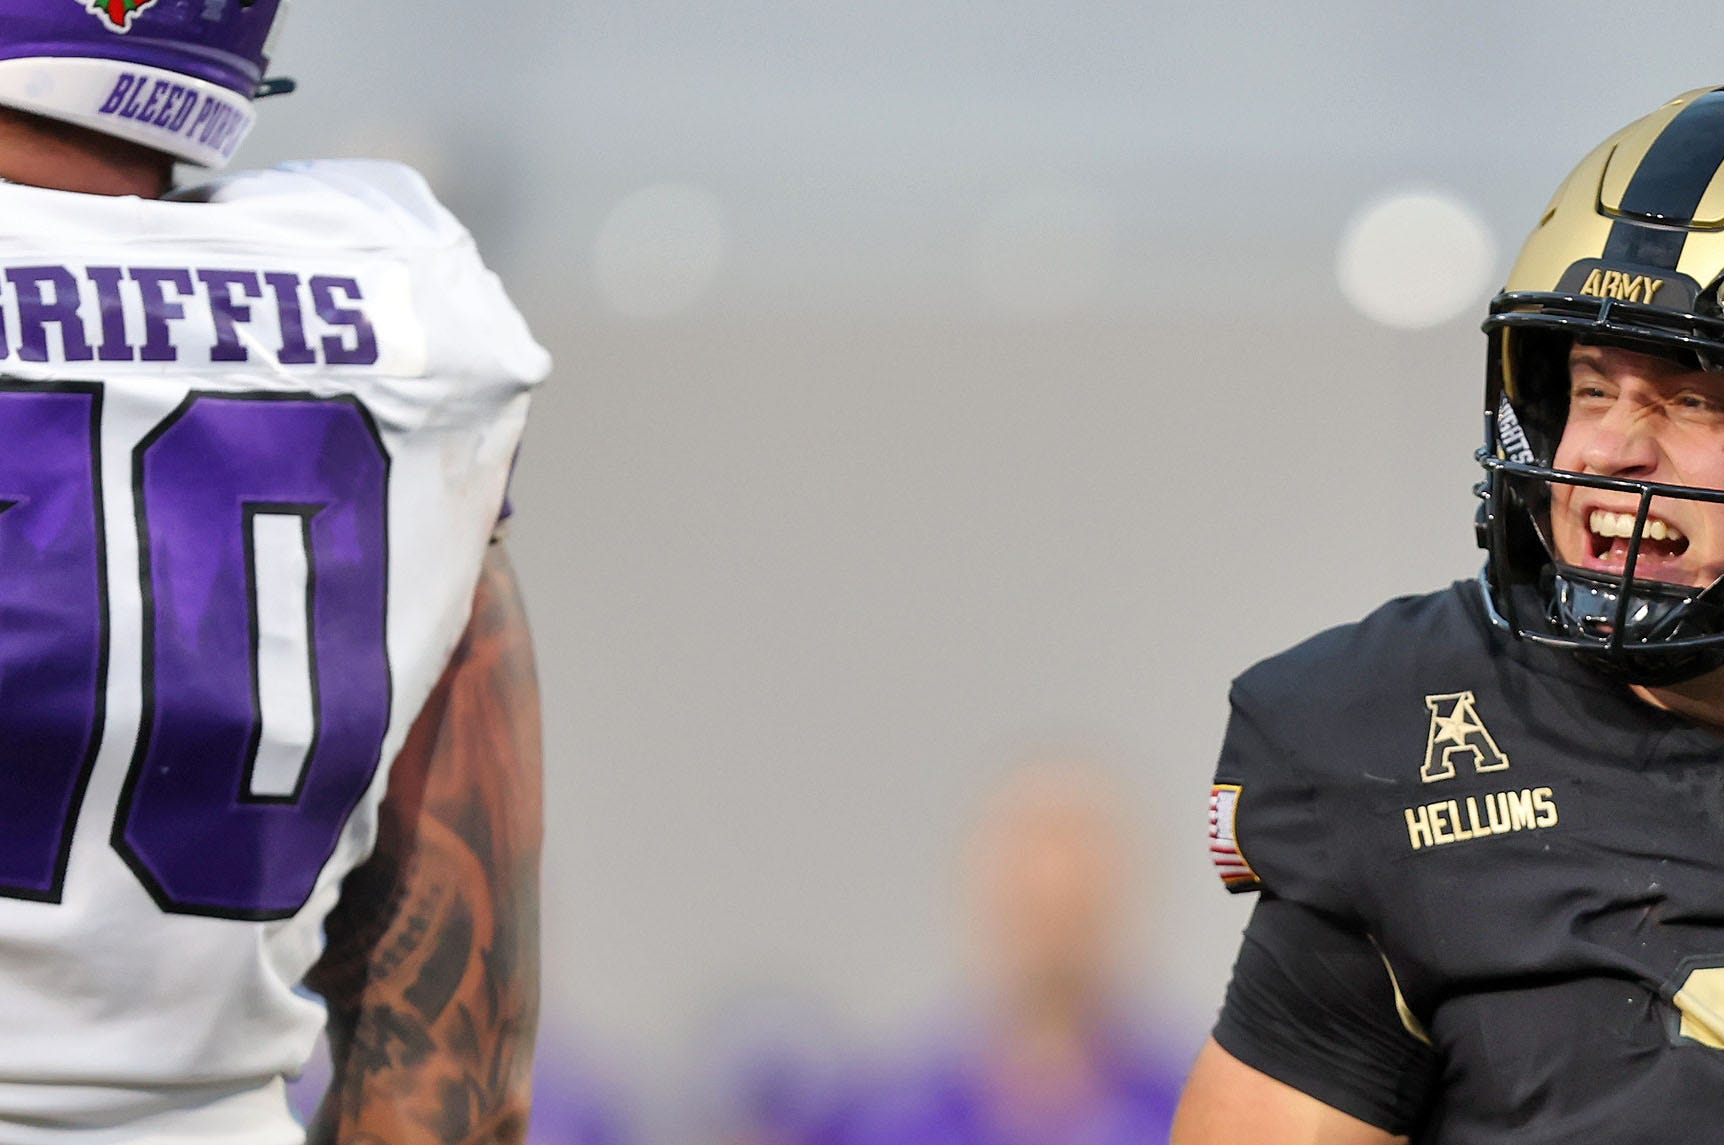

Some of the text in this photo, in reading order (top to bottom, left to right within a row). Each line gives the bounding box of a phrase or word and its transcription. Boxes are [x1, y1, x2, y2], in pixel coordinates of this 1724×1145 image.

[99, 73, 199, 132] BLEED
[0, 266, 378, 365] RIFFIS
[1579, 268, 1664, 305] ARMY
[1404, 786, 1560, 849] HELLUMS
